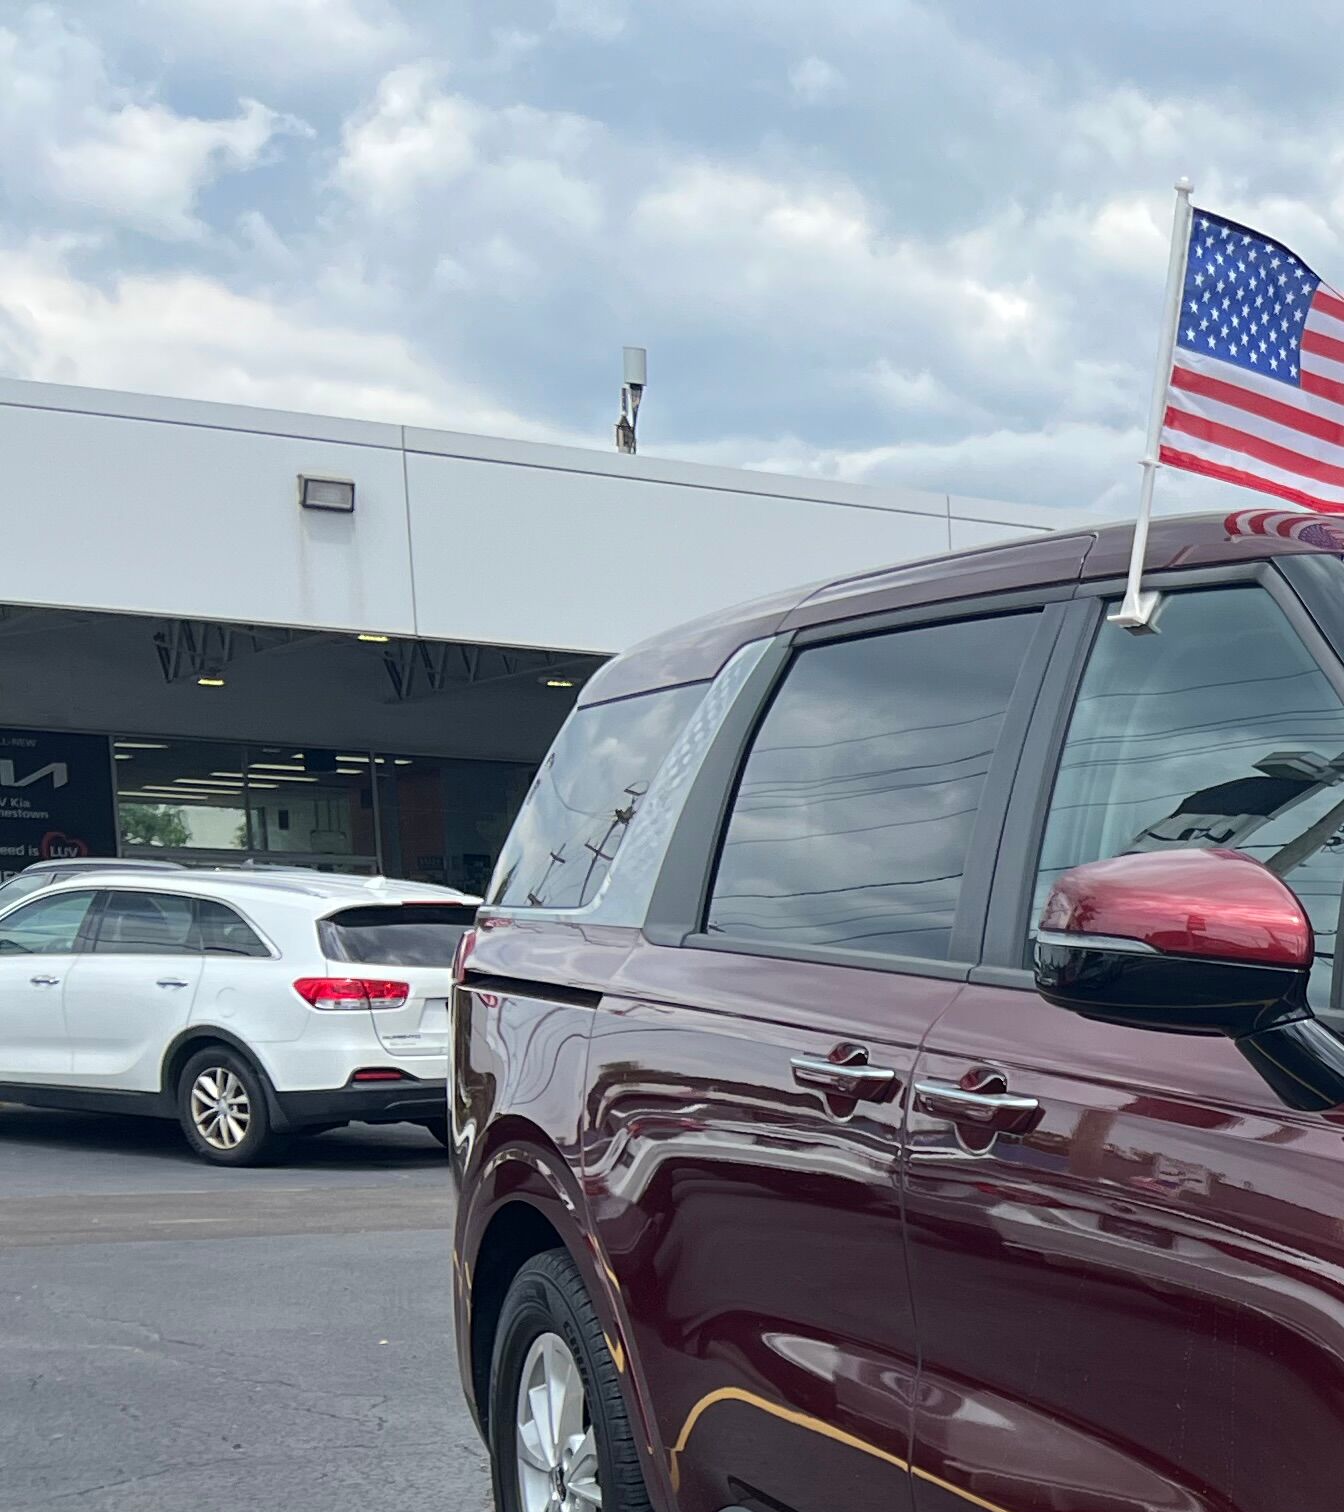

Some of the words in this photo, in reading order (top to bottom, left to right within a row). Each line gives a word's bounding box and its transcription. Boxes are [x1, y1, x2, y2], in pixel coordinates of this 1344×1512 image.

[10, 797, 31, 808] Kia
[28, 844, 39, 857] is
[50, 845, 79, 858] LUV
